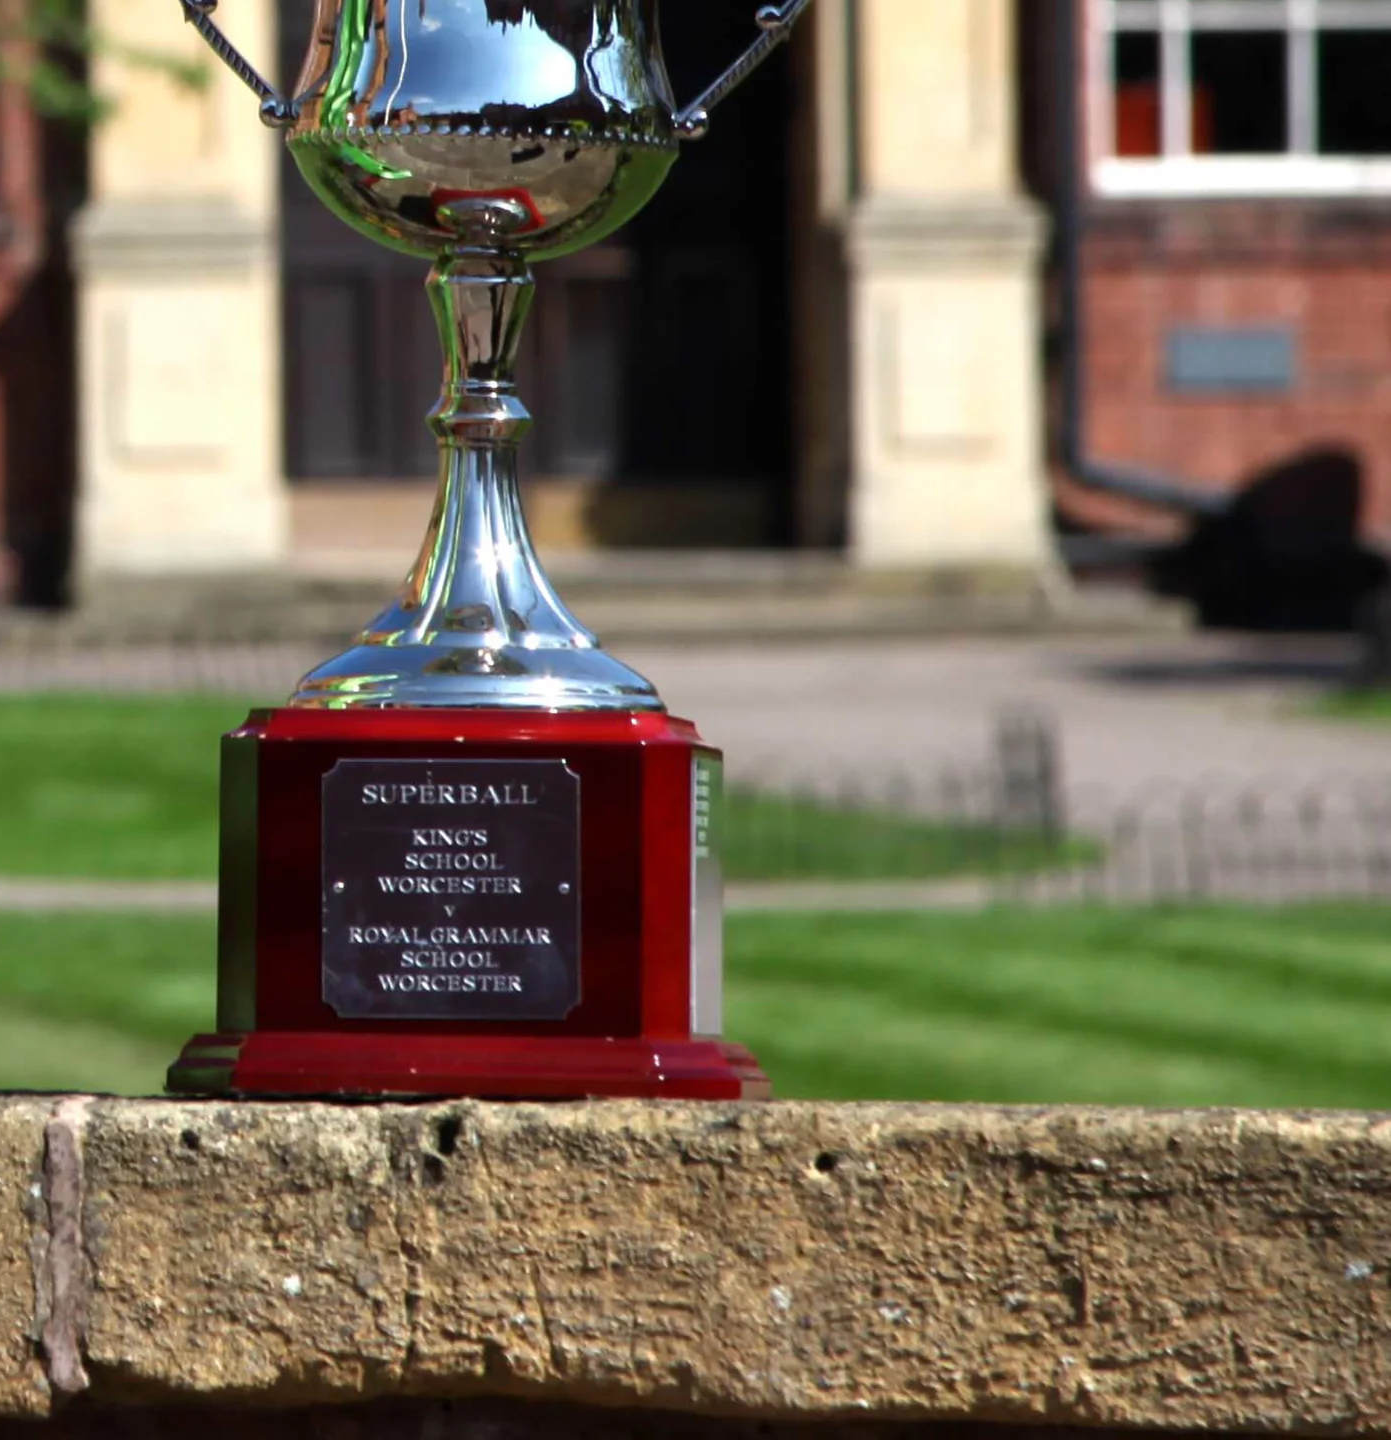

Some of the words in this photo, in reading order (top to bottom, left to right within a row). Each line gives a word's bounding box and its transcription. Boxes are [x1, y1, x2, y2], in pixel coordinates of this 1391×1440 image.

[361, 783, 538, 805] SUPERBALL
[412, 828, 488, 847] KING'S
[404, 852, 504, 871] SCHOOL
[377, 876, 523, 895] WORCESTER
[348, 926, 429, 945] ROYAL
[430, 926, 552, 945] GRAMMAR
[400, 950, 500, 969] SCHOOL
[377, 974, 524, 993] WORCESTER
